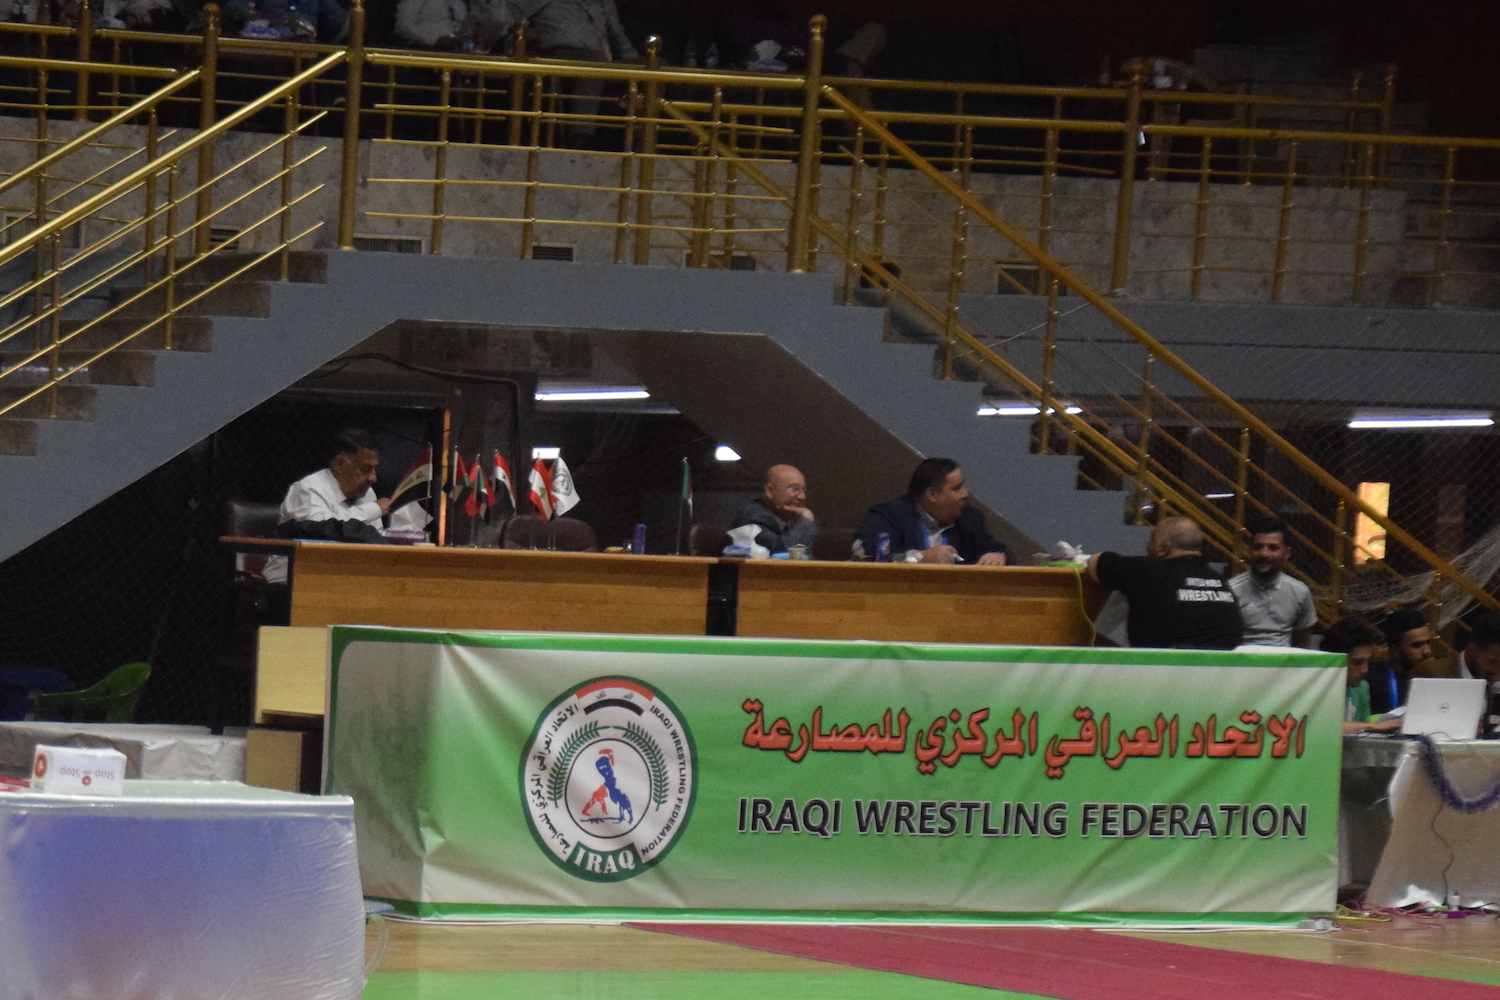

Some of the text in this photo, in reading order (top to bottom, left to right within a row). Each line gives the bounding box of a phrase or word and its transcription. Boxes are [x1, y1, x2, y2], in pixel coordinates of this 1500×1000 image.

[1178, 588, 1235, 603] WRESTLING
[742, 698, 1307, 779] الاتحاد العراقي المركزي للمصارعة
[641, 705, 687, 856] IRAQI WRESTLING FEDERATION
[737, 797, 1308, 839] IRAQI WRESTLING FEDERATION
[572, 847, 636, 874] IRAQ
